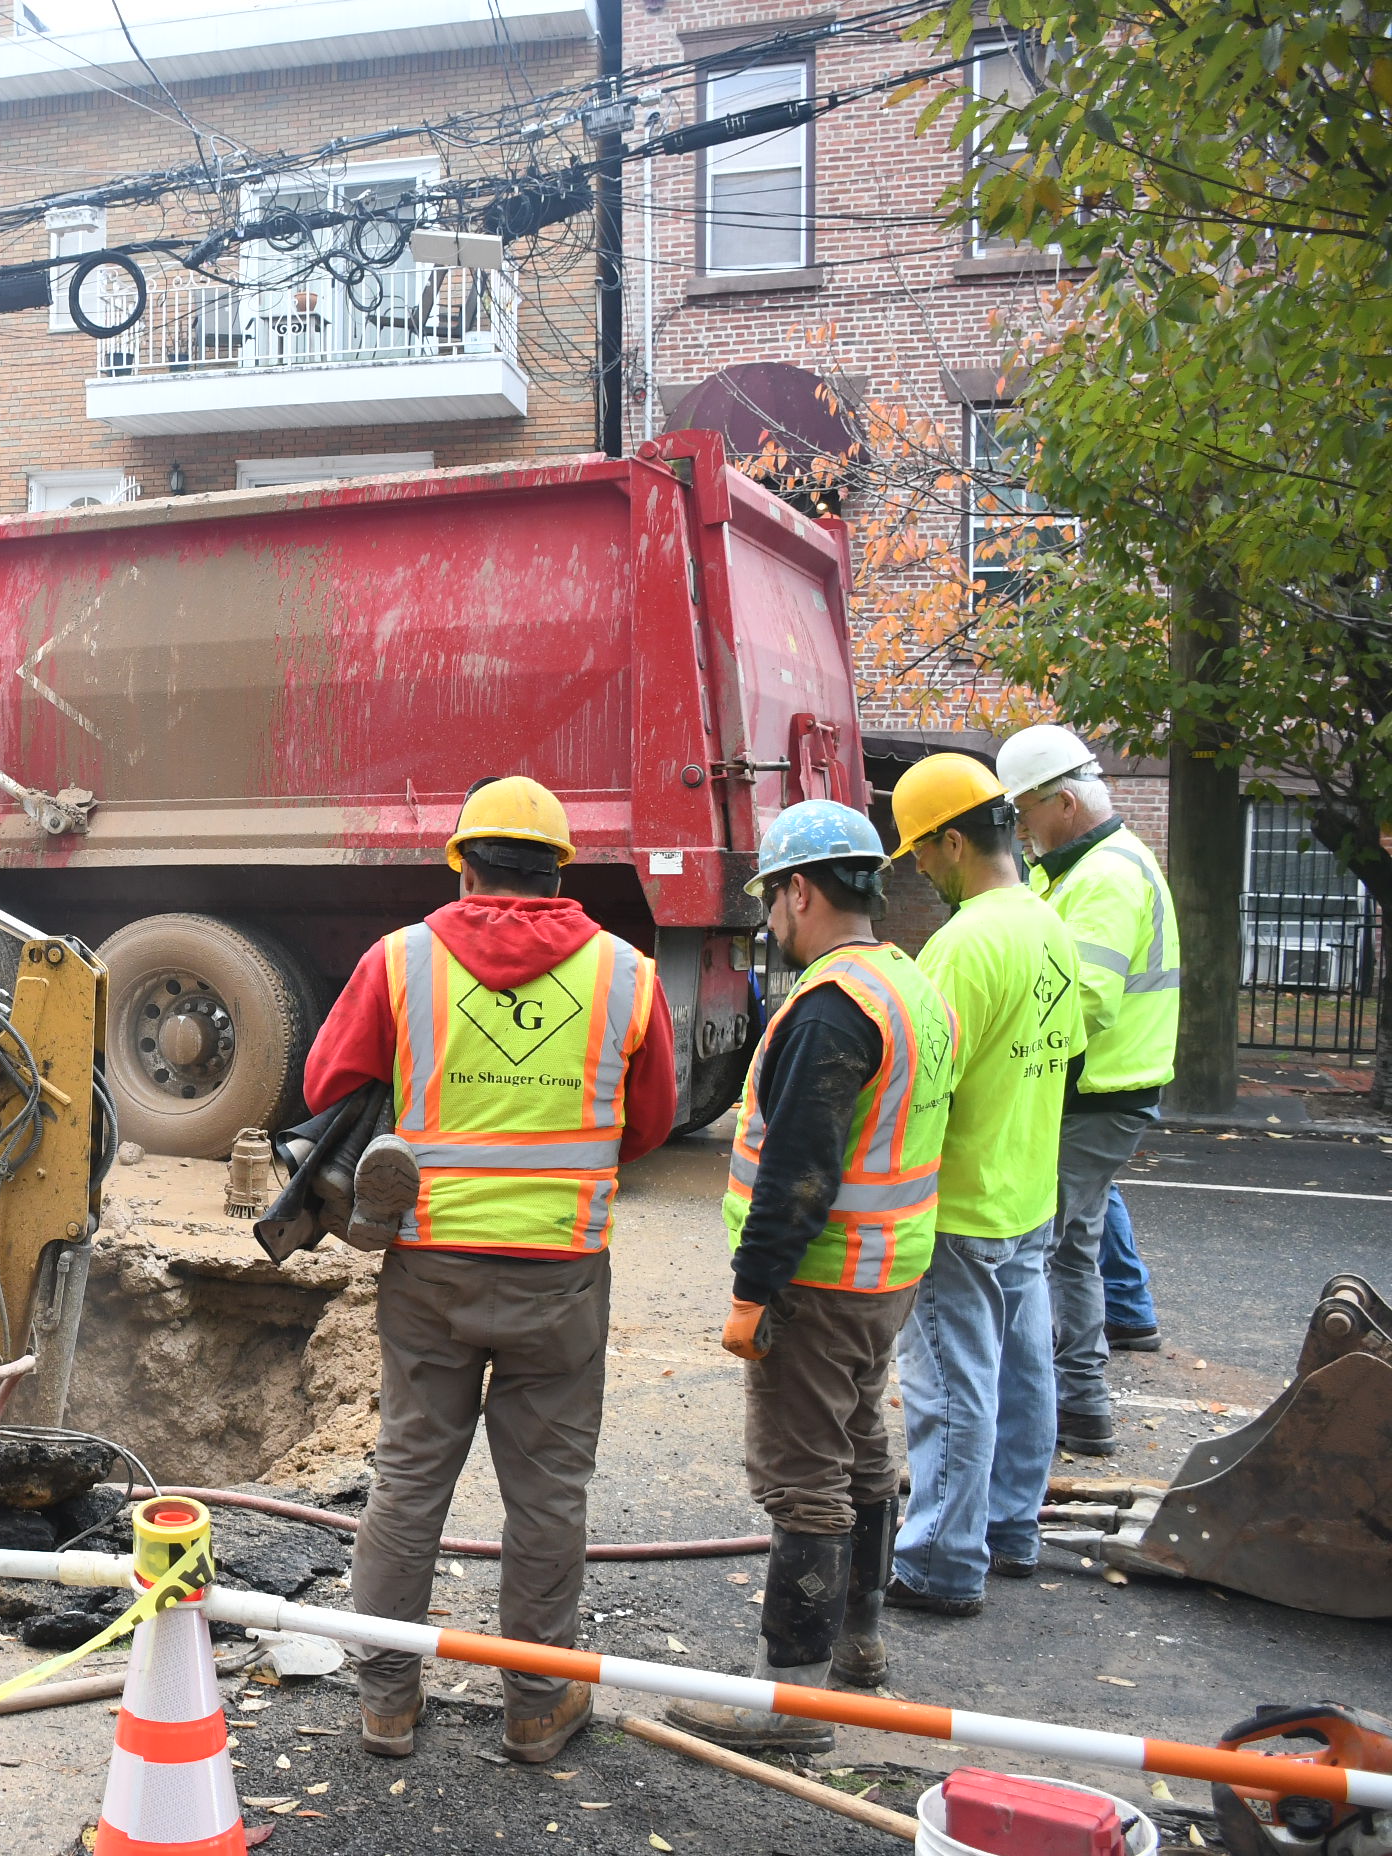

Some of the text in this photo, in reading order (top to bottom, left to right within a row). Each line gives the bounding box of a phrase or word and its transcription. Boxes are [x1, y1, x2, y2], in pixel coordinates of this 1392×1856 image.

[448, 1072, 582, 1090] The Shauger Group
